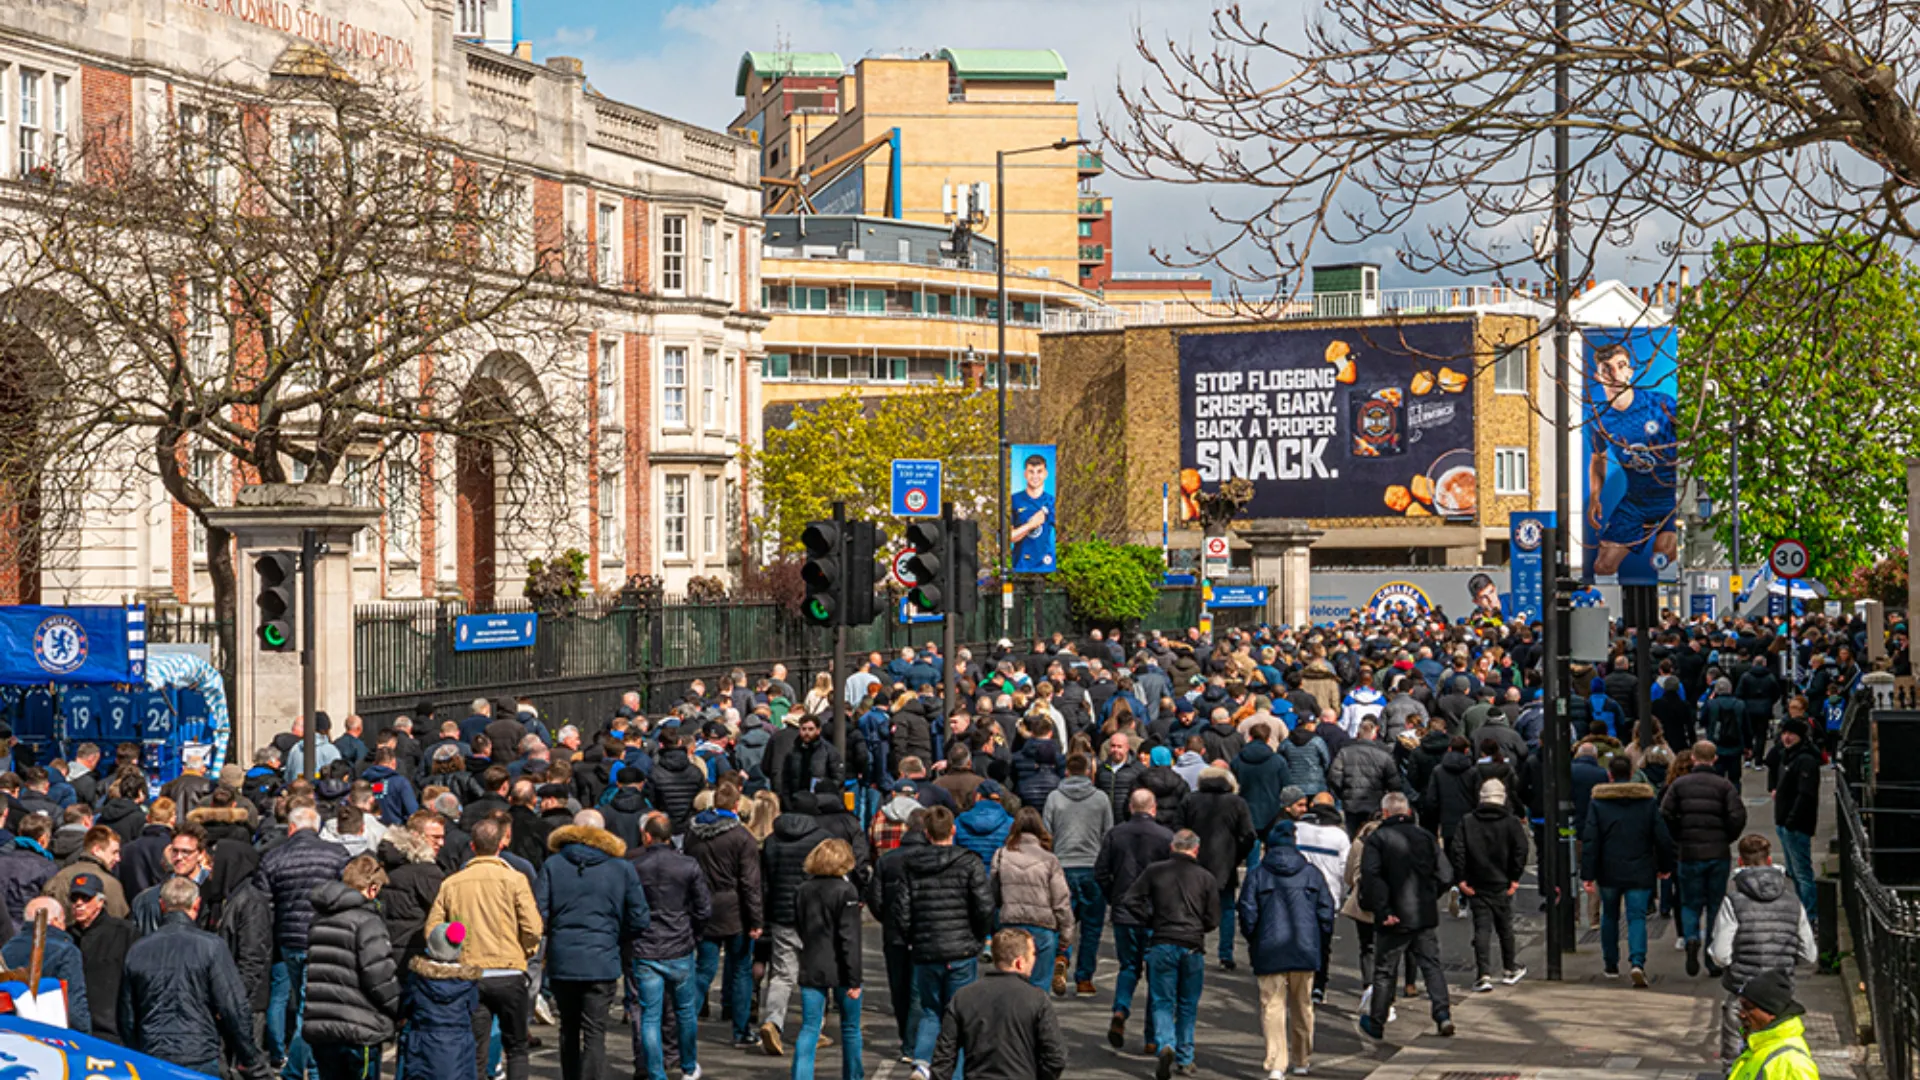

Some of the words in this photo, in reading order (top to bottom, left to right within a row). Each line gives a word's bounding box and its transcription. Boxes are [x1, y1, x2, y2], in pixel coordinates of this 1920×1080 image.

[238, 0, 292, 32] OSWALD
[295, 7, 334, 47] STOLL
[337, 20, 414, 69] FOUNDATION
[1195, 371, 1243, 393] STOP
[1247, 367, 1336, 391] FLOGGING
[1195, 393, 1272, 418] CRISPS,
[1276, 390, 1337, 415] GARY.
[1195, 419, 1243, 439] BACK
[1248, 418, 1262, 438] A
[1266, 415, 1337, 437] PROPER
[1196, 437, 1339, 482] SNACK.
[1776, 550, 1804, 567] 30
[1309, 603, 1356, 617] elcom
[72, 706, 90, 730] 19
[111, 706, 124, 731] 9
[147, 708, 171, 732] 24
[1827, 707, 1842, 721] 19
